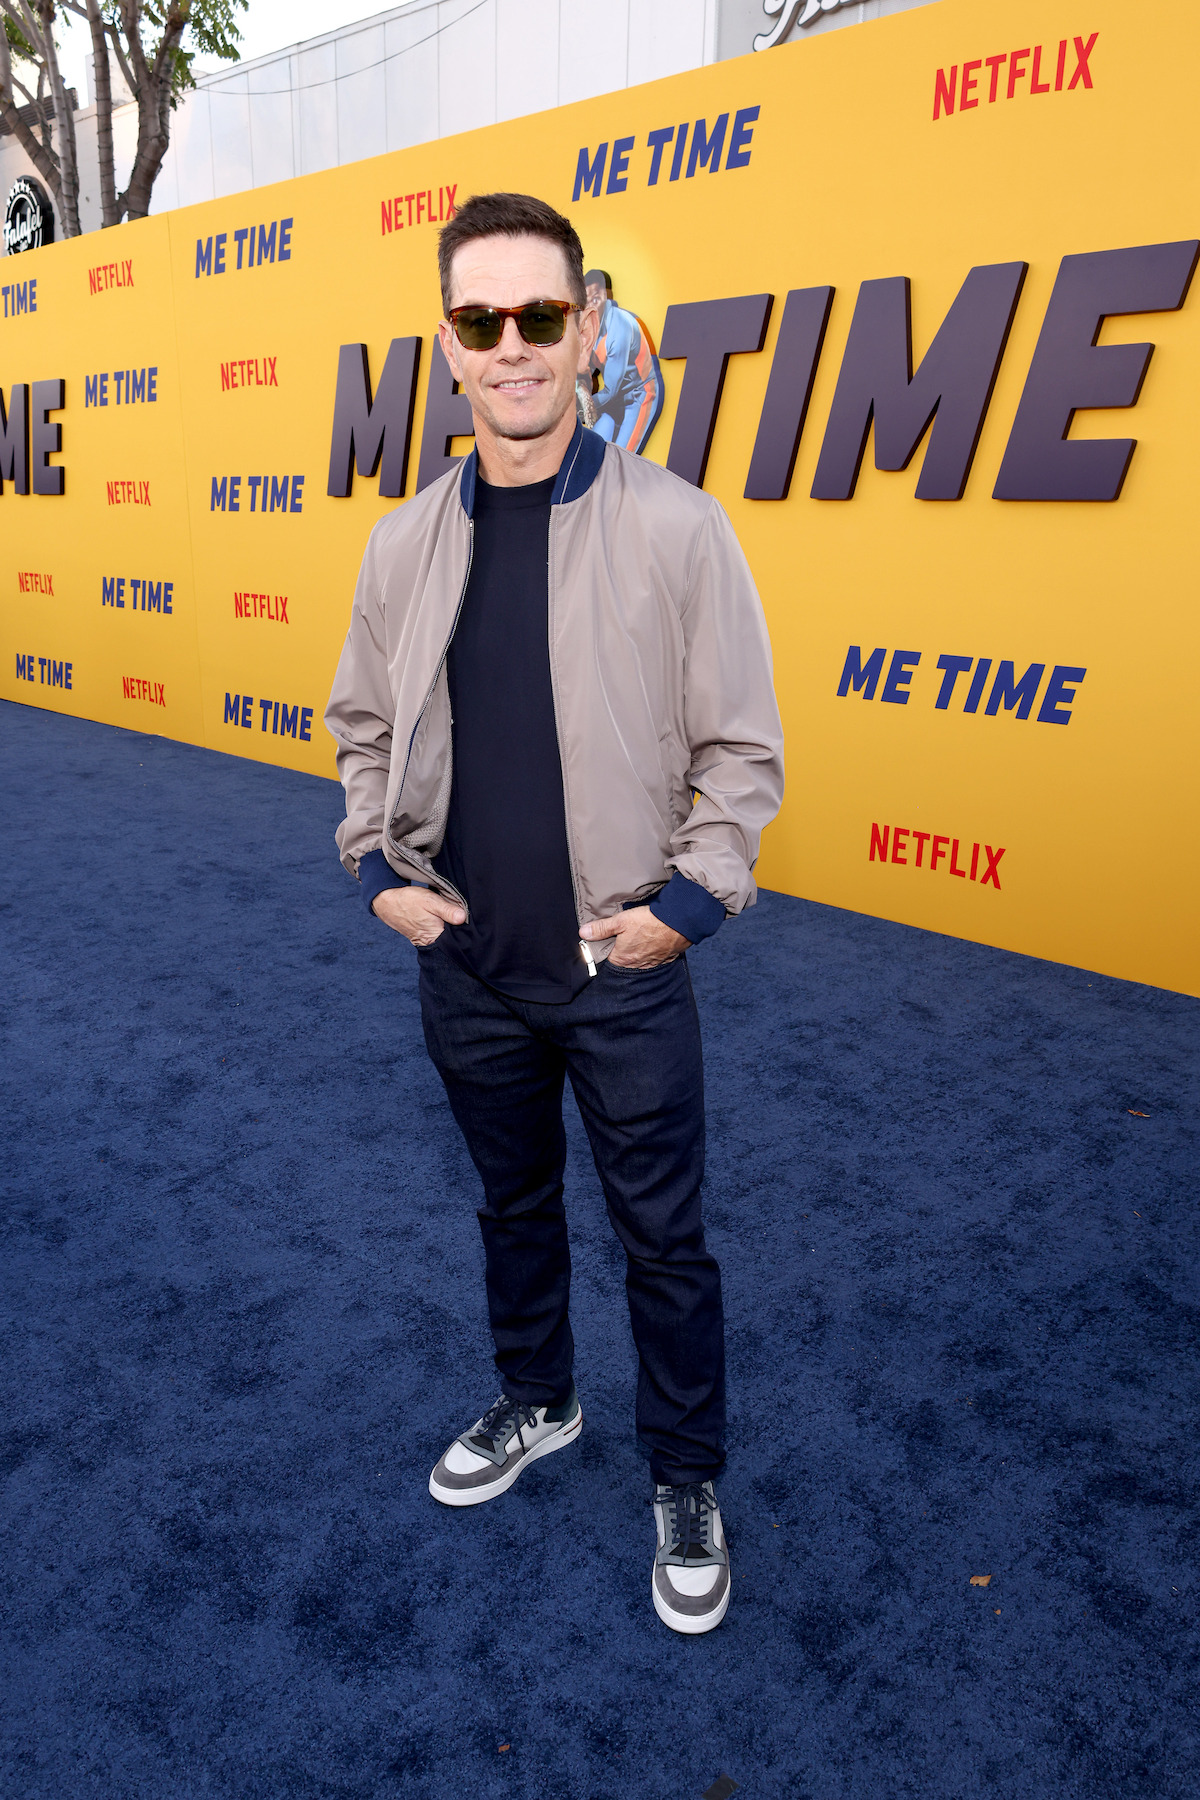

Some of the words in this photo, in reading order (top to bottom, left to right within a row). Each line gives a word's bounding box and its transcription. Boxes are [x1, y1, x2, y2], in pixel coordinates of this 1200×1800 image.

[932, 32, 1100, 121] NETFLIX
[571, 135, 635, 202] ME
[647, 105, 761, 186] TIME
[3, 204, 43, 250] Falafel
[381, 183, 458, 237] NETFLIX
[195, 233, 227, 278] ME
[234, 217, 294, 270] TIME
[88, 259, 134, 295] NETFLIX
[1, 279, 37, 318] TIME
[85, 373, 109, 408] ME
[114, 366, 158, 405] TIME
[220, 356, 278, 392] NETFLIX
[659, 239, 1200, 501] TIME
[106, 480, 151, 507] NETFLIX
[210, 476, 242, 512] ME
[247, 475, 305, 513] TIME
[18, 571, 54, 597] NETFLIX
[102, 576, 126, 608] ME
[130, 579, 174, 614] TIME
[234, 591, 289, 625] NETFLIX
[16, 653, 35, 682] ME
[38, 657, 73, 690] TIME
[122, 675, 166, 708] NETFLIX
[836, 645, 922, 705] ME
[934, 654, 1087, 725] TIME
[223, 692, 254, 729] ME
[259, 699, 314, 742] TIME
[868, 822, 1007, 891] NETFLIX
